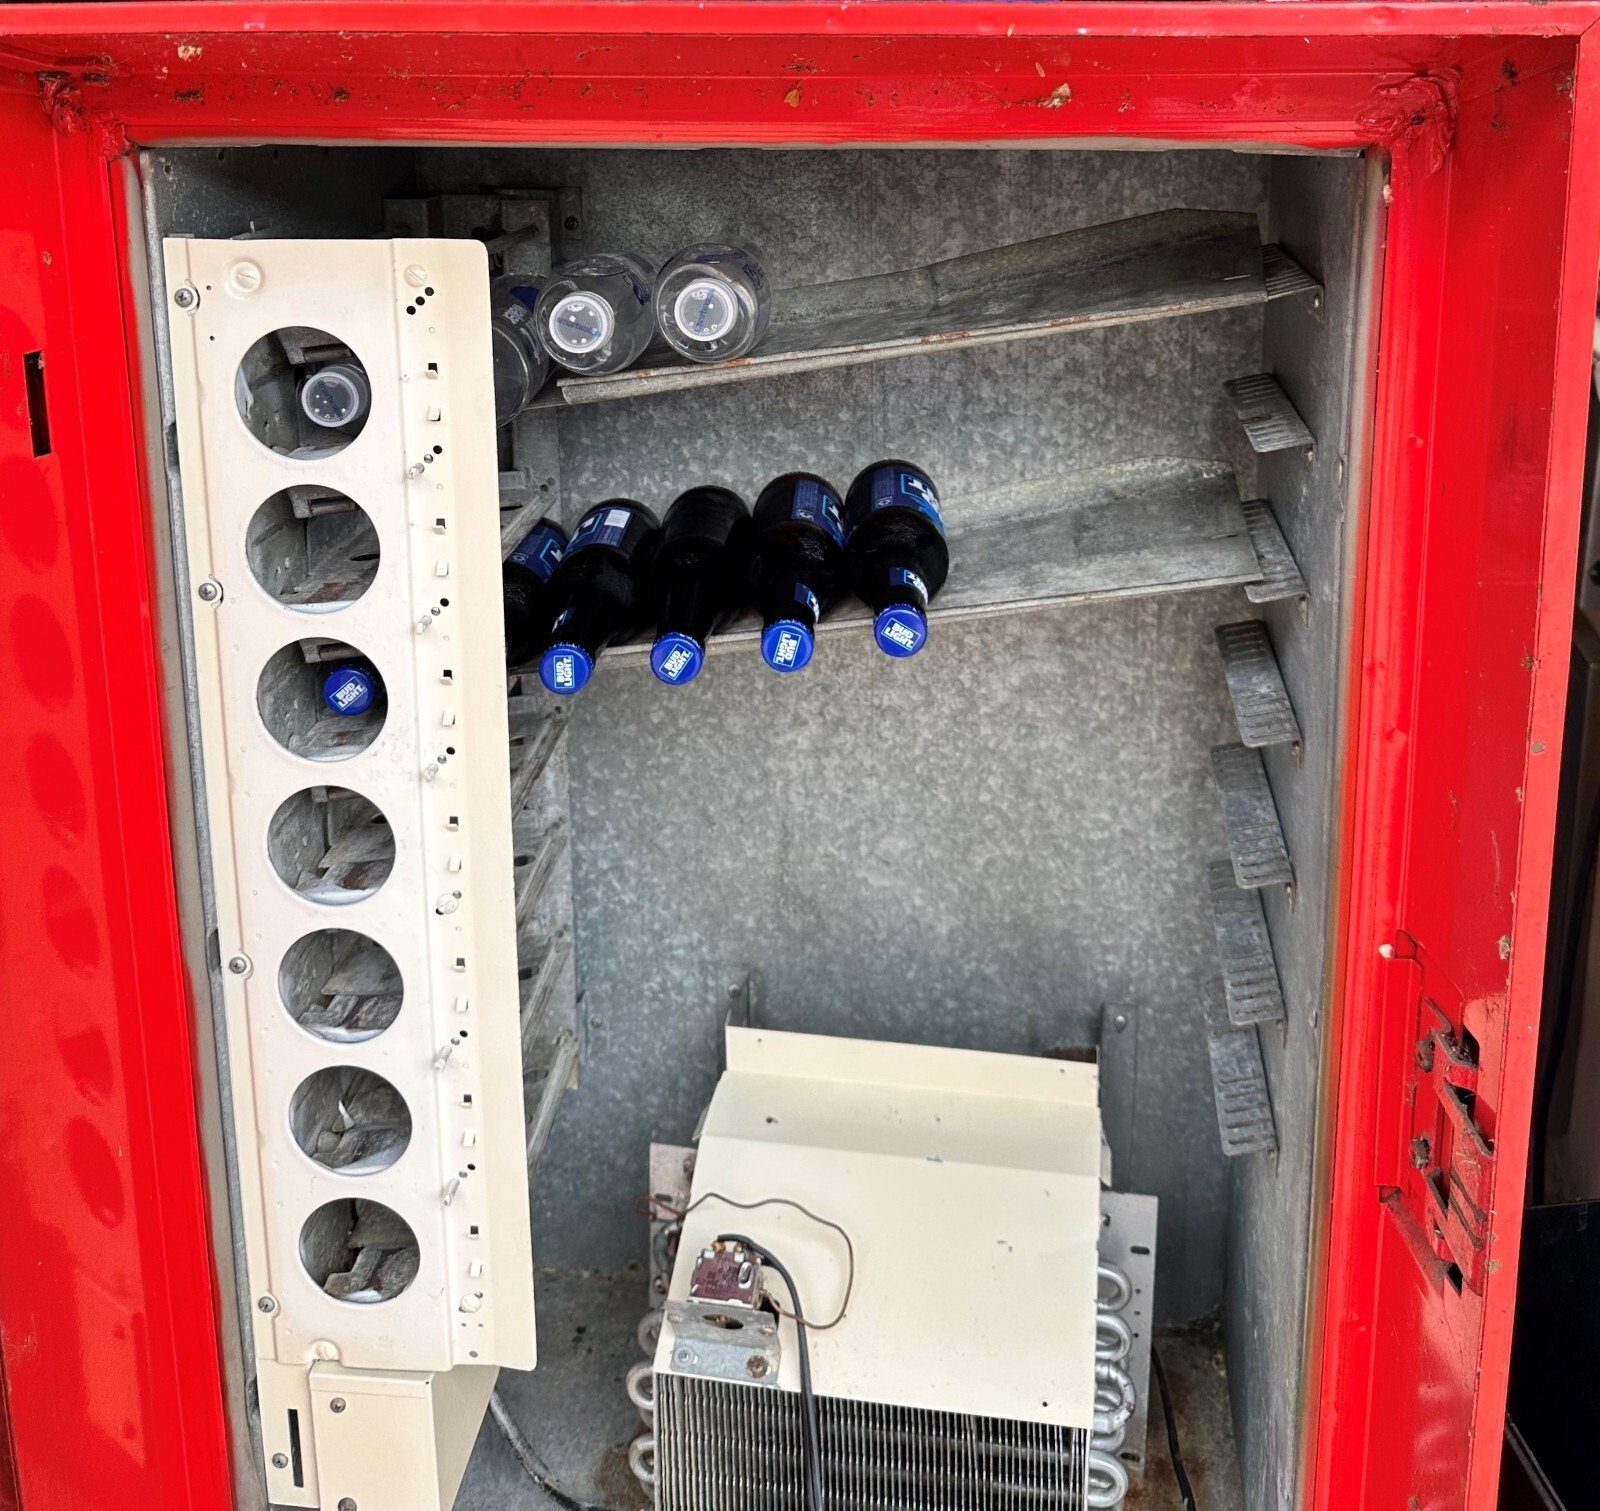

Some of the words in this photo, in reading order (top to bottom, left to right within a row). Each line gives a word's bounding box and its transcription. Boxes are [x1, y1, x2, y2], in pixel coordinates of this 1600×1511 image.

[892, 622, 914, 639] BUD
[785, 638, 798, 661] BUD
[663, 650, 681, 671] BUD
[556, 661, 565, 683] BUD
[335, 682, 356, 700] BUD
